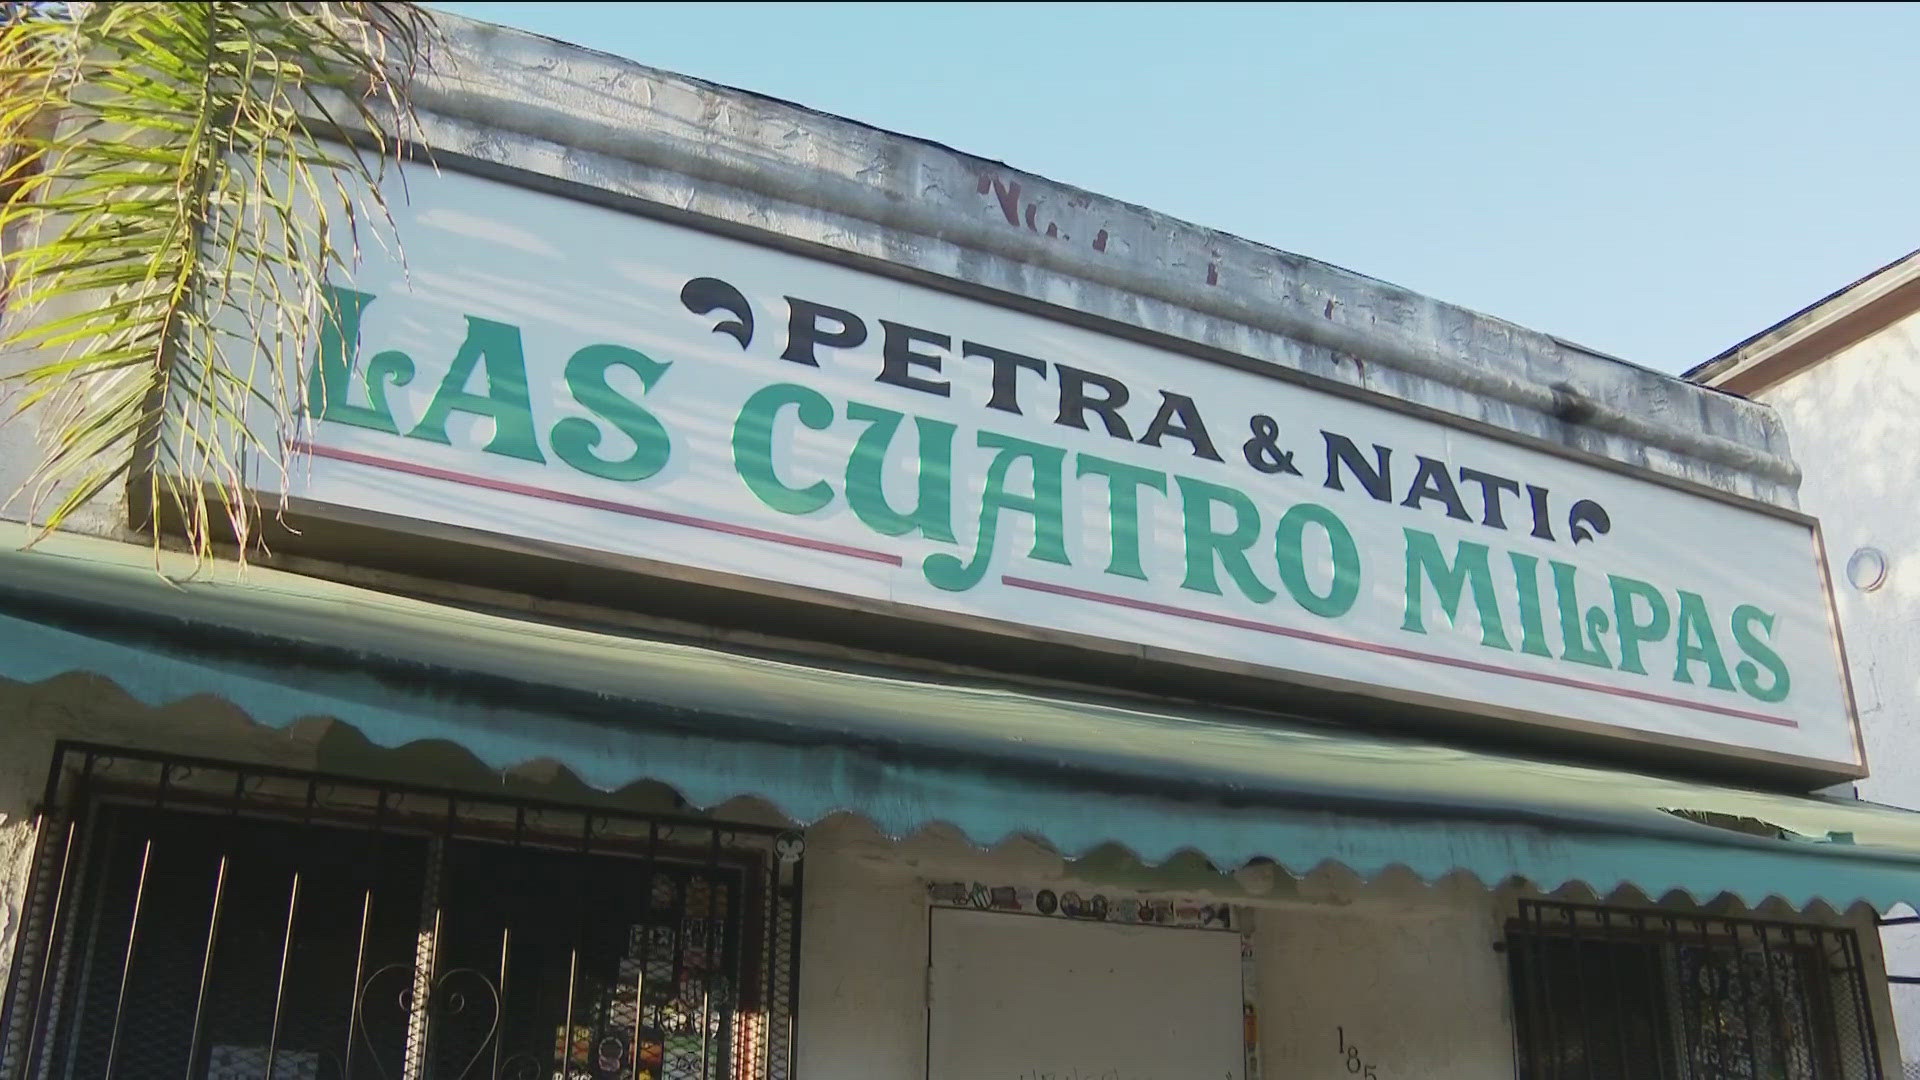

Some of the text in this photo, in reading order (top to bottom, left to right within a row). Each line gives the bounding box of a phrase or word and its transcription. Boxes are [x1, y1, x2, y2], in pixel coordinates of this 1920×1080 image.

[293, 286, 1790, 700] LAS CUATRO MILPAS
[781, 295, 1556, 542] PETRA & NATI
